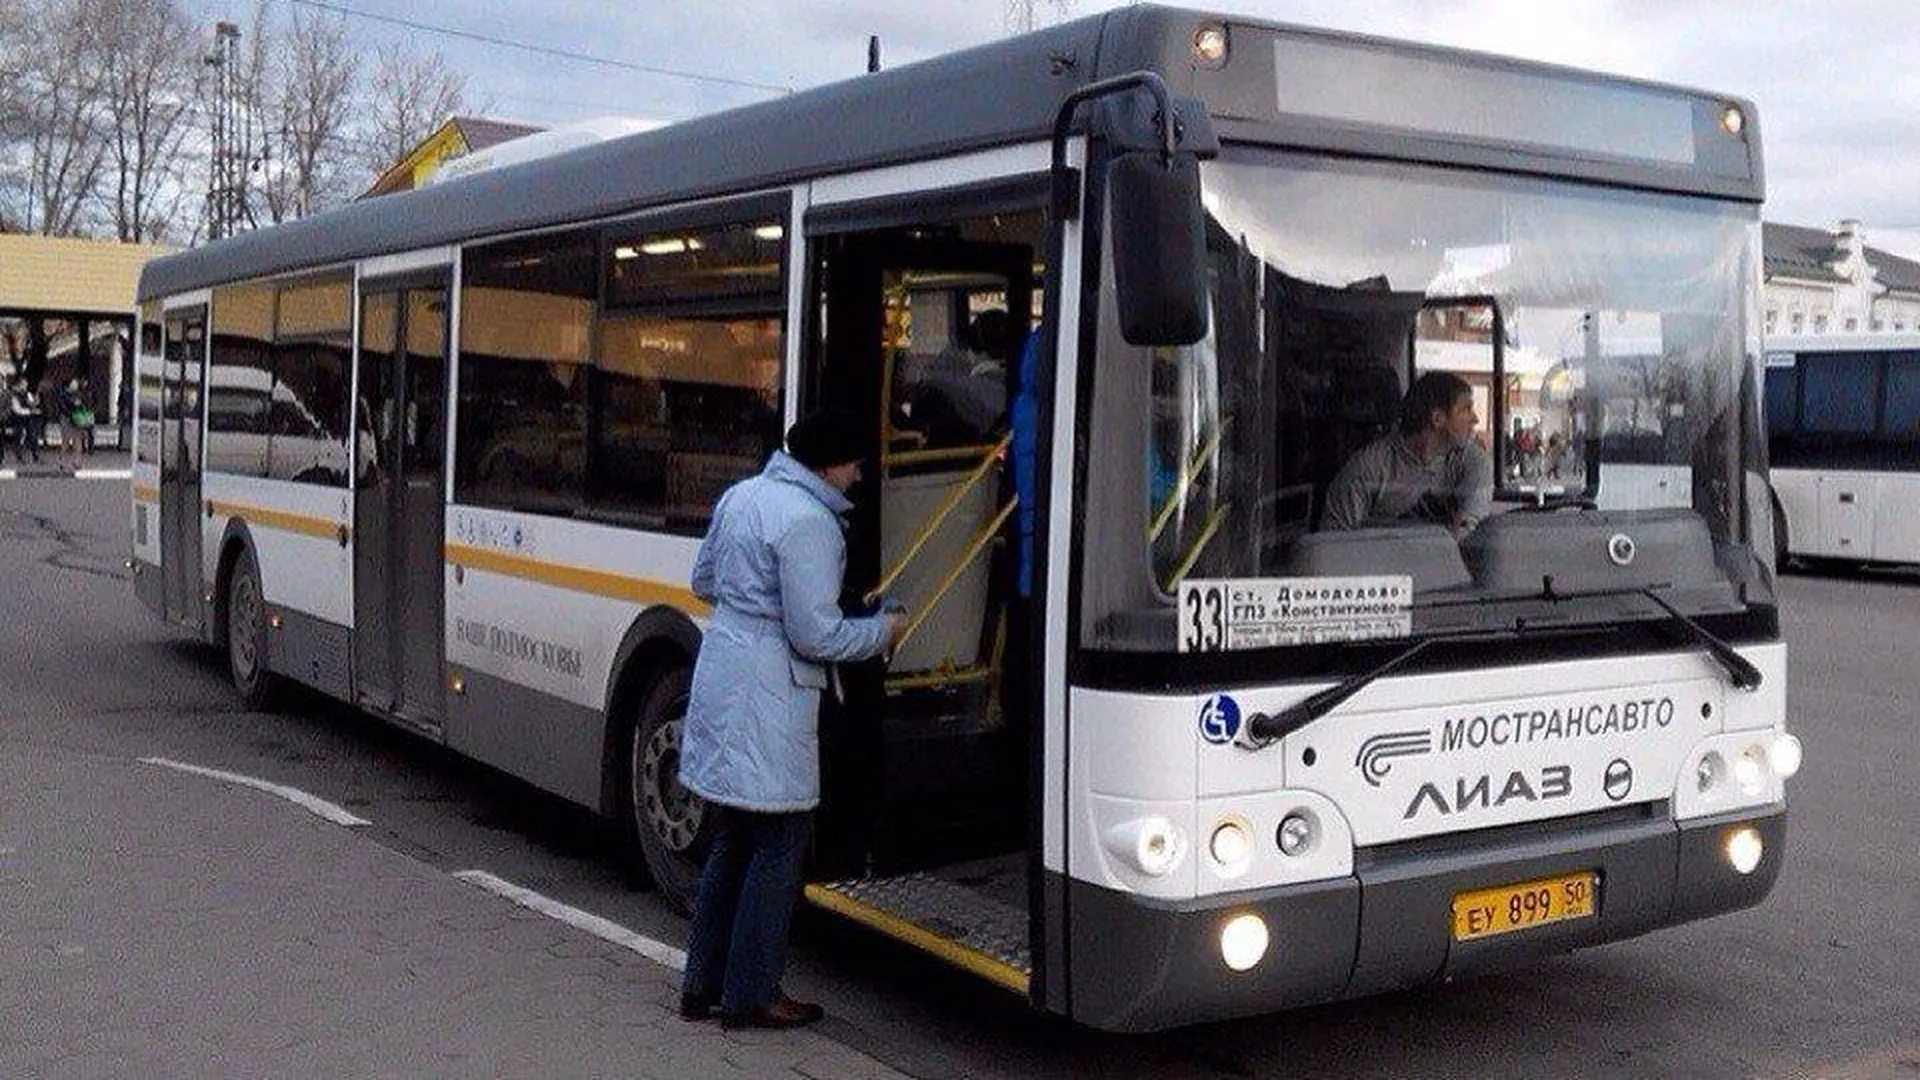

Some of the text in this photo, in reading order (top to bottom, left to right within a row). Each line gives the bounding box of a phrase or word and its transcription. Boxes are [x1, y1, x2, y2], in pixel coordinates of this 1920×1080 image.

[1186, 587, 1223, 652] 33
[1233, 604, 1266, 621] ГПЗ
[1441, 697, 1675, 751] МОСТРАНСАВТО
[1403, 765, 1573, 819] ЛИАЗ
[1509, 889, 1551, 924] 899
[1564, 881, 1585, 905] 50
